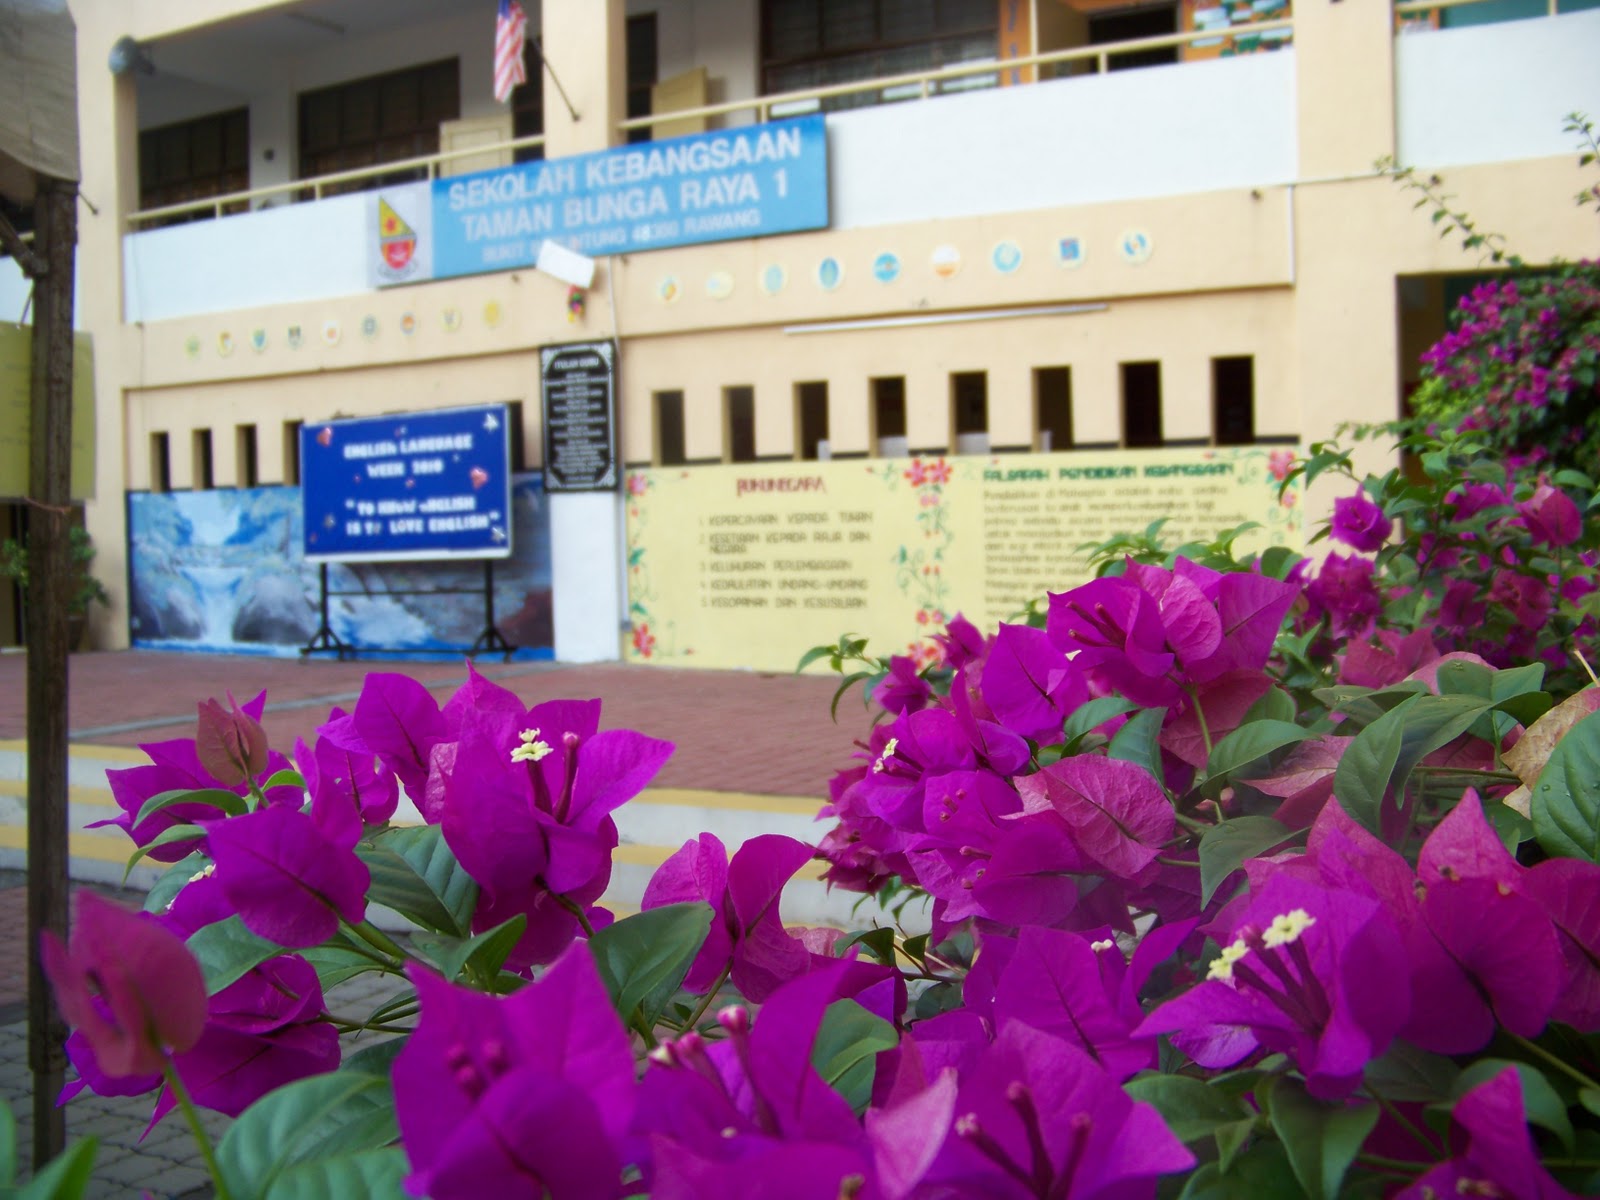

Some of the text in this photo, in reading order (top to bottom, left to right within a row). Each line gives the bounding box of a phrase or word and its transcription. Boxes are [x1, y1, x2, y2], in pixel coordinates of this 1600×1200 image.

[449, 128, 800, 212] SEKOLAH KEBANGSAAN
[461, 168, 788, 243] TAMAN BUNGA RAYA 1
[483, 240, 525, 262] BUKIT
[684, 208, 760, 233] RAWANG
[344, 434, 472, 459] ENGLISH LANGUAGE
[367, 462, 405, 478] WEEK
[346, 521, 361, 536] IS
[390, 518, 423, 534] LOVE
